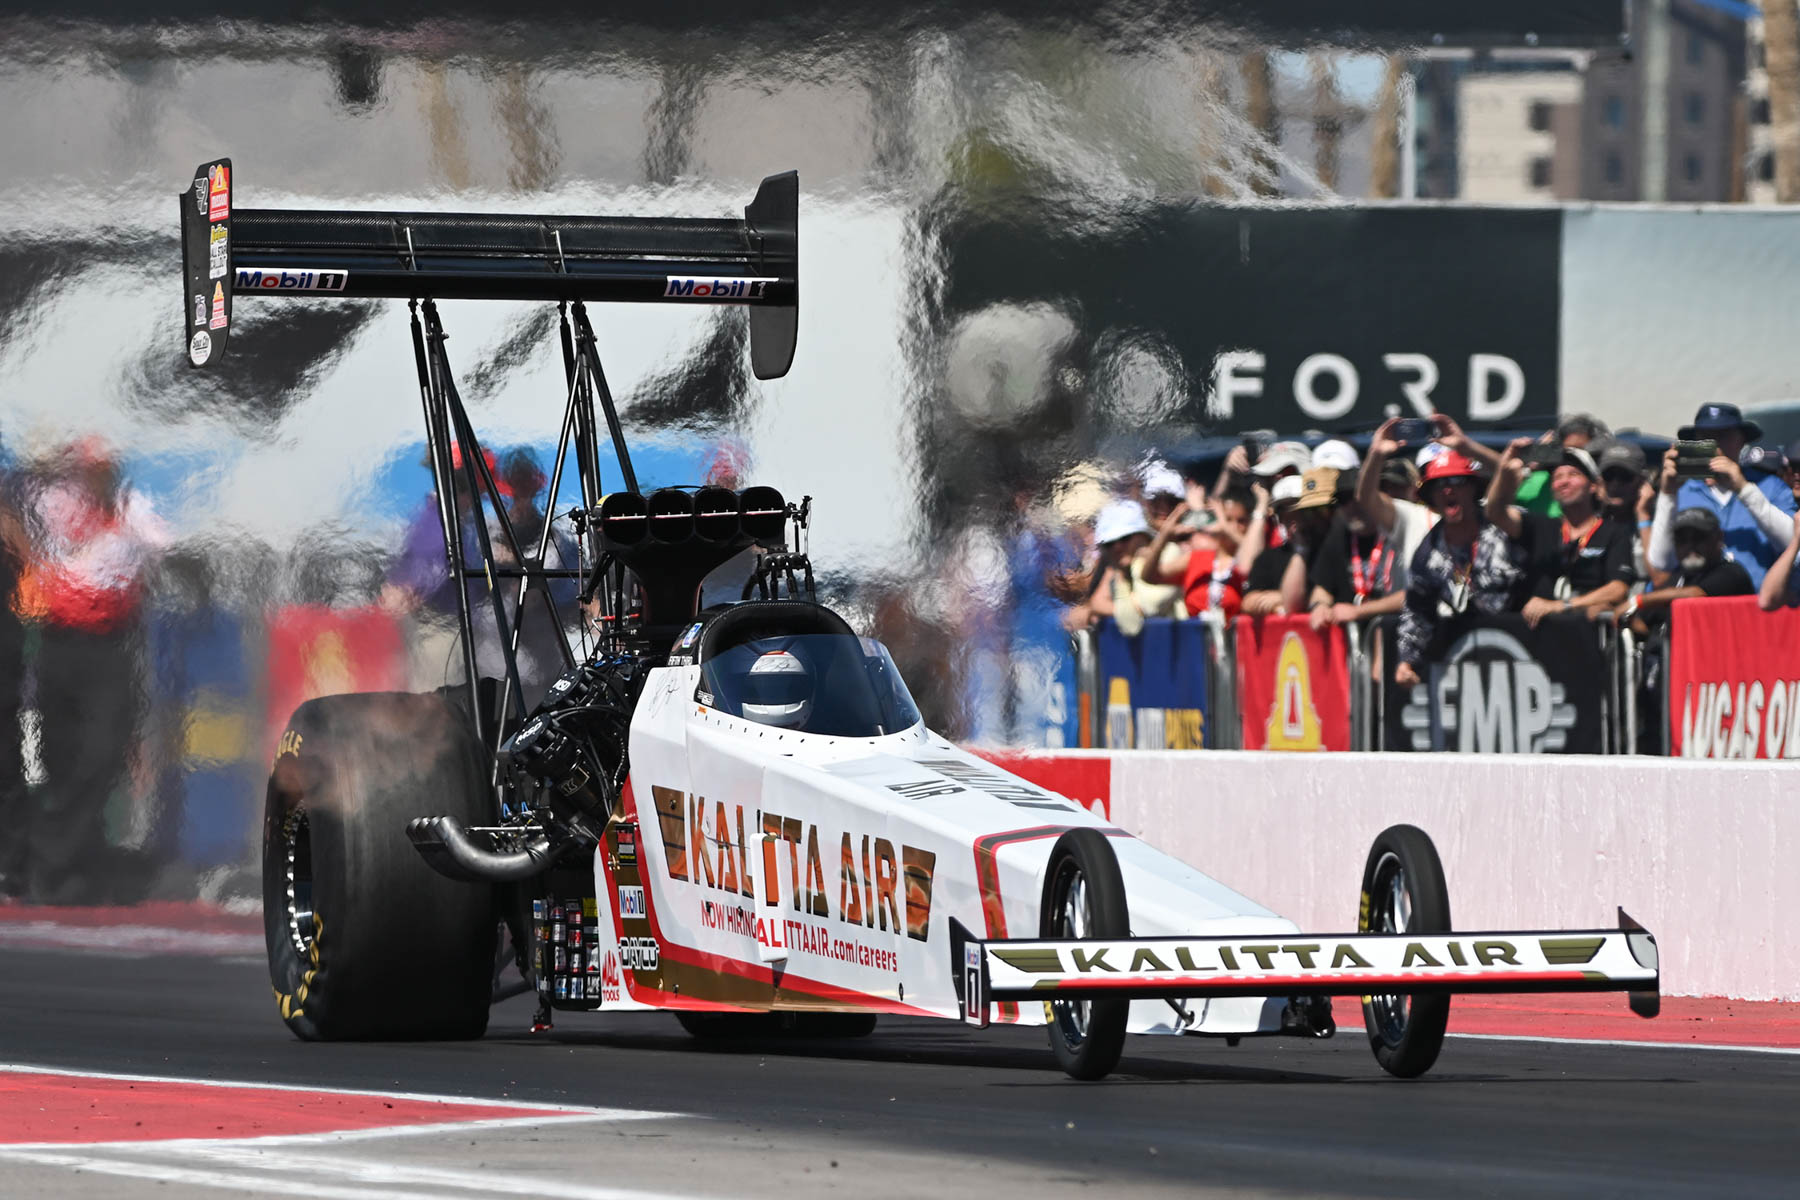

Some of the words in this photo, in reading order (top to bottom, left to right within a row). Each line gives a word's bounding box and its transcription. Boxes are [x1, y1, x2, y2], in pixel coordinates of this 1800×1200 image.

[237, 271, 313, 289] Mobil
[669, 279, 745, 297] Mobil
[1207, 350, 1527, 422] FORD
[690, 792, 829, 918] KALTTA
[840, 831, 901, 935] AIR
[619, 889, 638, 915] Mobil
[700, 900, 724, 929] NOW
[757, 917, 898, 973] ALITTAAIR.com/careers
[620, 937, 658, 970] DAYCO
[1070, 943, 1375, 973] KALITTA
[1400, 940, 1524, 969] AIR
[602, 990, 620, 1002] TOOLS
